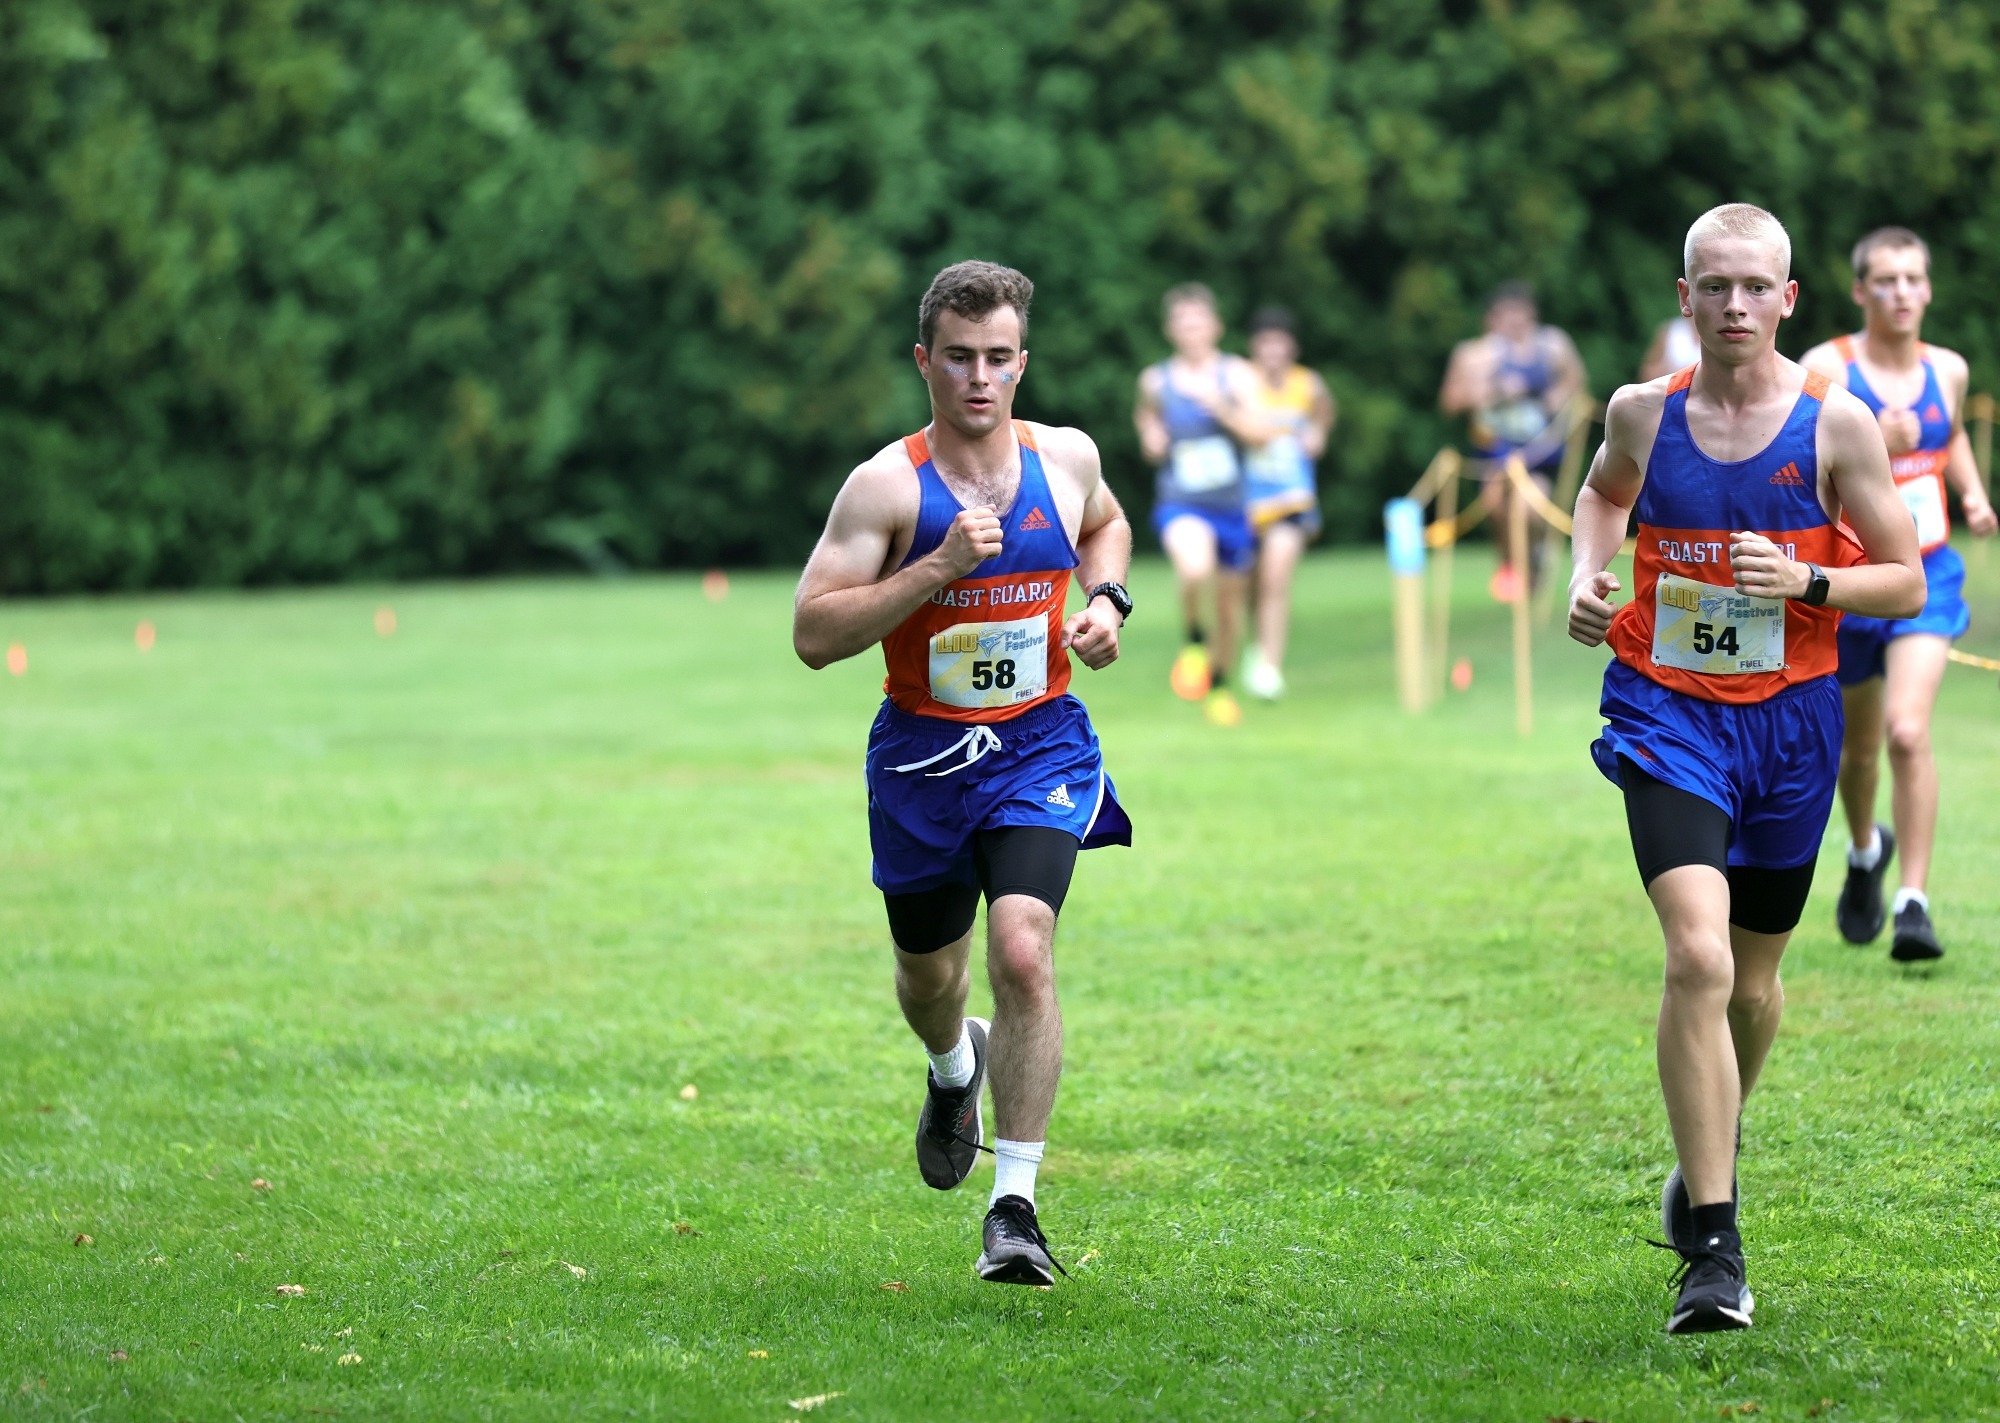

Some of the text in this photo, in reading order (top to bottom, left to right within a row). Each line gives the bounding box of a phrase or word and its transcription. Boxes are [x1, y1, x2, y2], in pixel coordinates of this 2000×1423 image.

[1768, 476, 1804, 486] adidas
[1019, 520, 1052, 531] adidas
[1658, 539, 1723, 564] COAST
[928, 581, 1053, 608] OAST GUARD
[1661, 583, 1700, 613] LIU
[1726, 597, 1751, 608] Fall
[1726, 606, 1779, 619] Festival
[936, 633, 979, 654] LIU
[1004, 628, 1026, 642] Fall
[1004, 632, 1046, 652] Festival
[1693, 622, 1740, 656] 54
[1740, 660, 1763, 669] FUEL
[971, 658, 1016, 691] 58
[1015, 688, 1034, 699] FUEL
